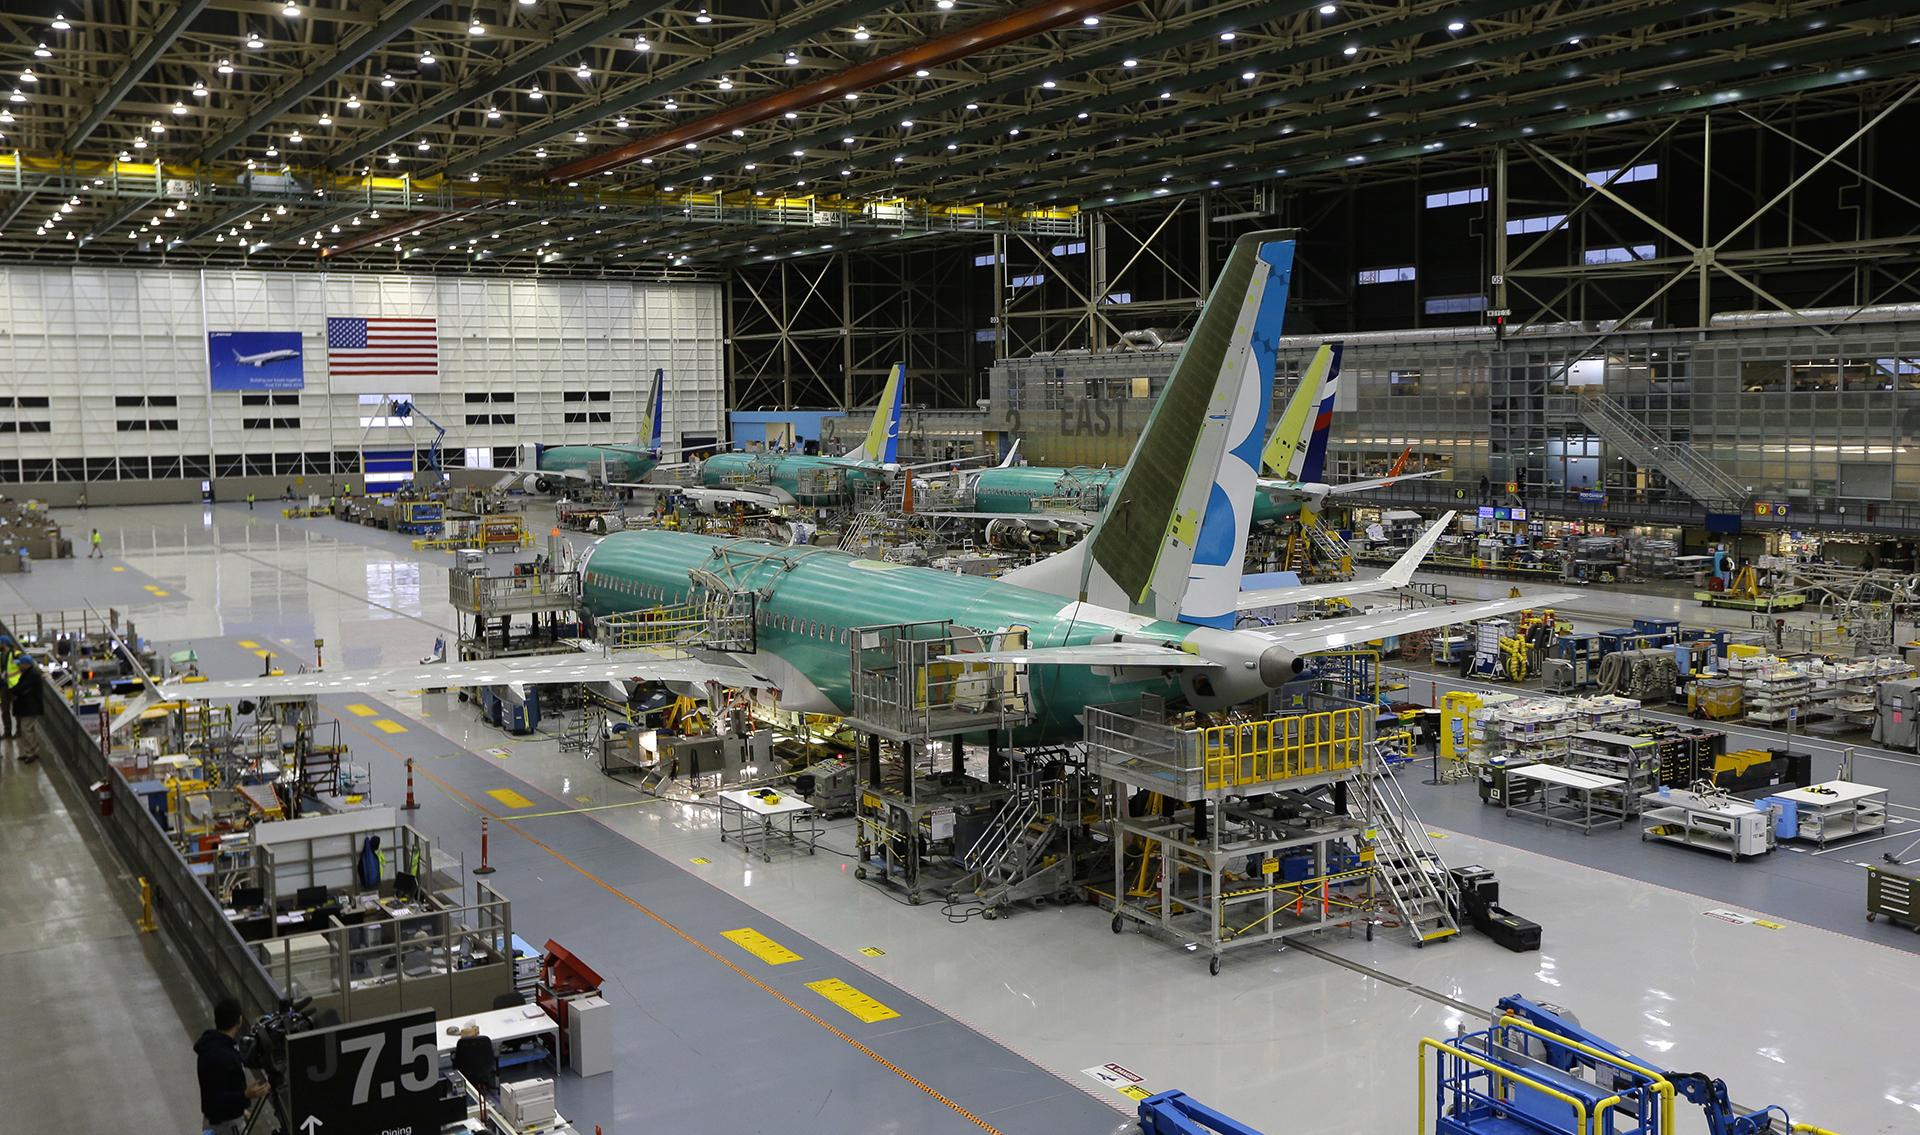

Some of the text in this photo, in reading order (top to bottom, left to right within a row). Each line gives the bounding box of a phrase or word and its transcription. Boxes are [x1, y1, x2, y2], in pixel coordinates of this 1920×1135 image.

[1061, 397, 1128, 437] EAST
[1113, 1067, 1142, 1082] DANGER
[381, 1126, 412, 1135] Dining
